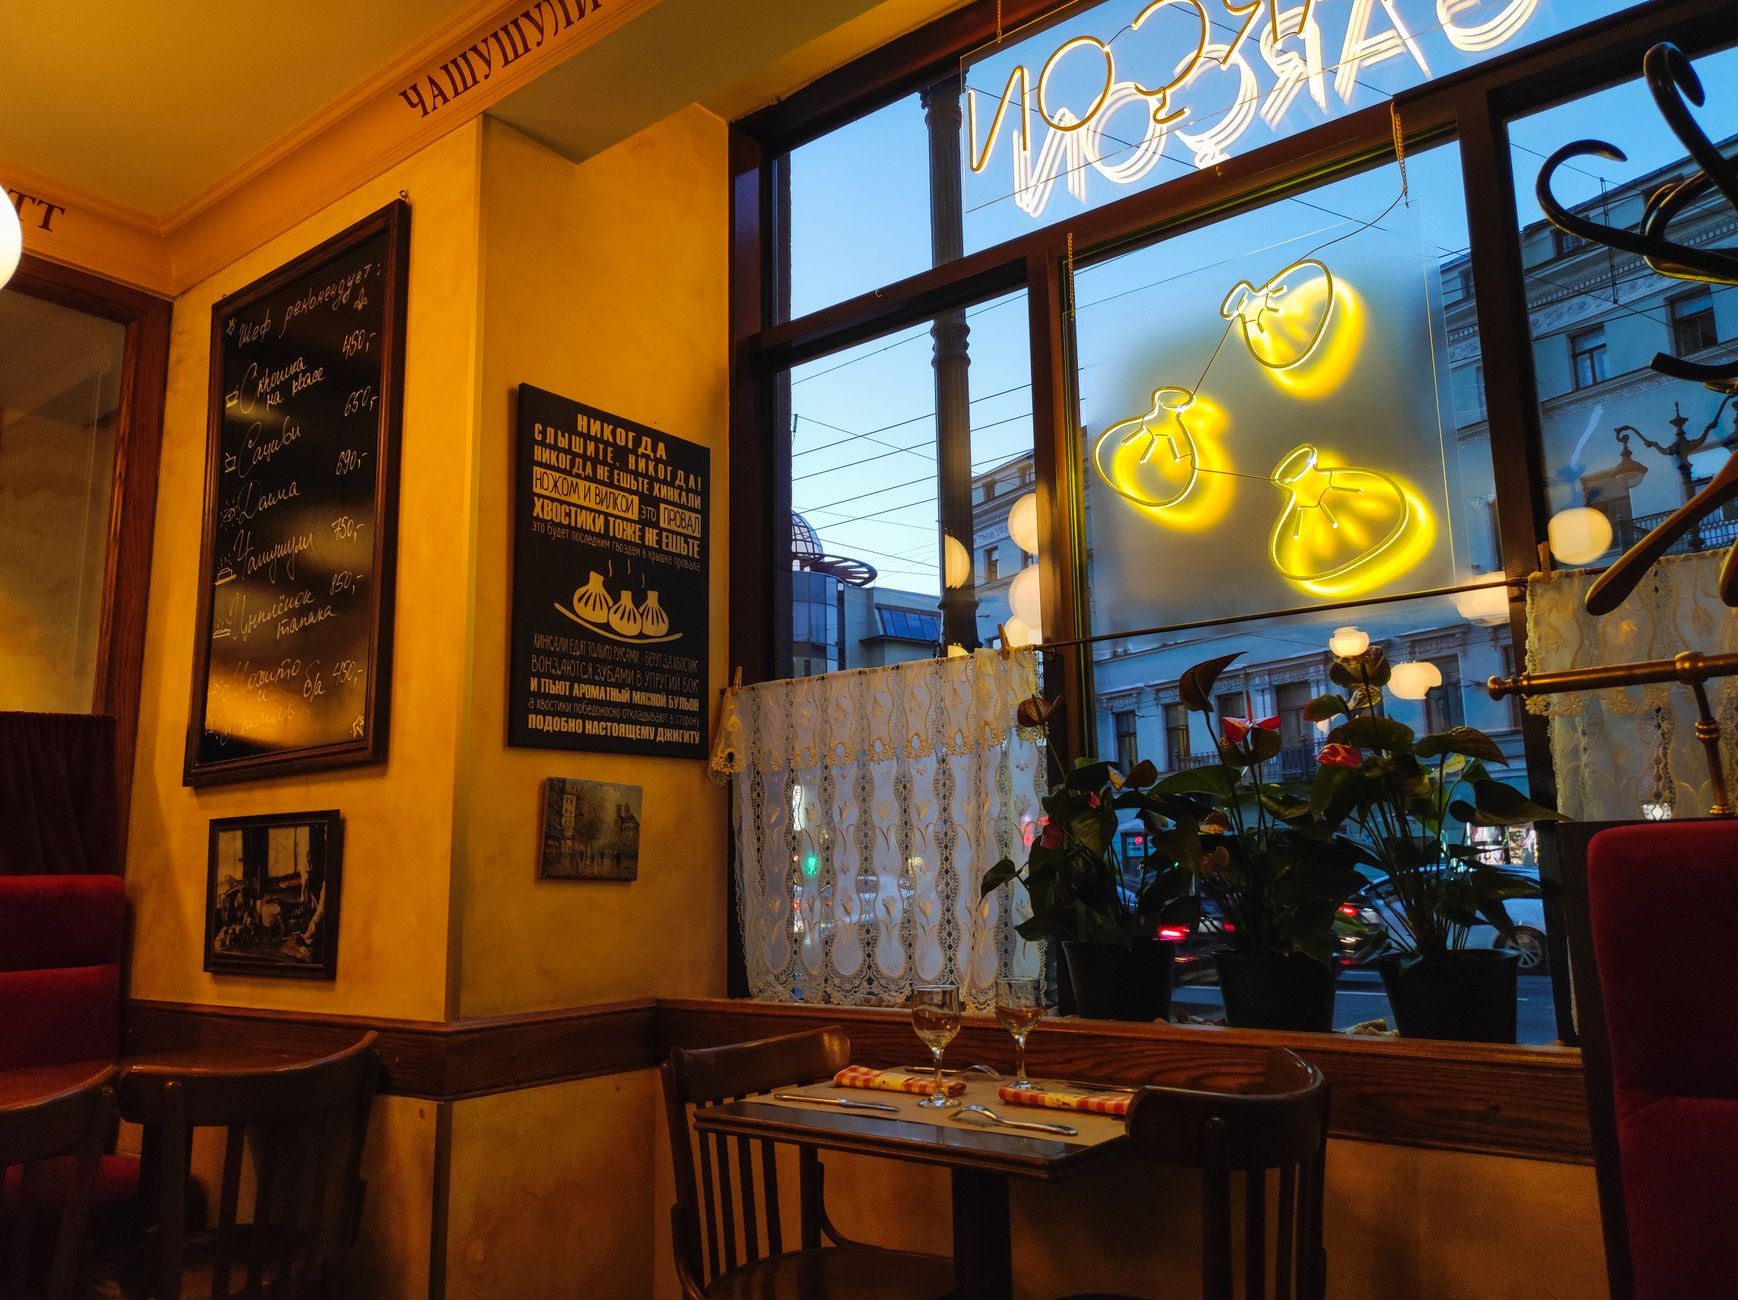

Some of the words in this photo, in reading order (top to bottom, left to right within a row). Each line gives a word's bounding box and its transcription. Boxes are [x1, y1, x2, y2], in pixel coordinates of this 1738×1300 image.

[238, 308, 272, 348] Шеф
[266, 391, 285, 411] на
[292, 367, 327, 396] квасе
[534, 423, 620, 467] СЛЫШИТЕ,
[628, 453, 702, 492] НИКОГДА!
[577, 413, 667, 461] НИКОГДА
[533, 444, 593, 478] НИКОГДА
[597, 464, 610, 483] НЕ
[613, 469, 649, 495] ЕШЬТЕ
[653, 482, 701, 510] ХИНКАЛИ
[535, 471, 580, 498] НОЖОМ
[583, 487, 591, 503] И
[640, 505, 657, 522] это
[663, 507, 701, 535] ПРОВАЛ
[532, 496, 605, 535] ХВОСТИКИ
[608, 517, 642, 544] ТОЖЕ
[645, 527, 659, 549] НЕ
[662, 532, 700, 559] ЕШЬТЕ
[532, 521, 545, 534] это
[547, 521, 570, 542] будет
[571, 530, 610, 550] последним
[673, 556, 701, 573] провала
[533, 632, 568, 652] ХИНКАЛИ
[569, 638, 587, 655] ЕДЯТ
[588, 641, 613, 660] ТОЛЬКО
[613, 645, 640, 664] РУКАМИ
[530, 677, 538, 692] И
[540, 678, 571, 696] ПЬЮТ
[572, 682, 631, 704] АРОМАТНЫЙ
[632, 690, 667, 708] МЯСНОЙ
[668, 695, 699, 712] БУЛЬОН
[531, 654, 593, 679] ВОНЗАЮТСЯ
[595, 664, 634, 686] ЗУБАМИ
[636, 669, 643, 686] В
[682, 675, 699, 695] БОК
[527, 714, 583, 733] ПОДОБНО
[585, 719, 655, 740] НАСТОЯЩЕМУ
[656, 727, 700, 744] ДЖИГИТУ
[528, 697, 535, 709] а
[536, 698, 572, 713] хвостики
[573, 700, 621, 719] победоносно
[622, 708, 668, 723] откладывают
